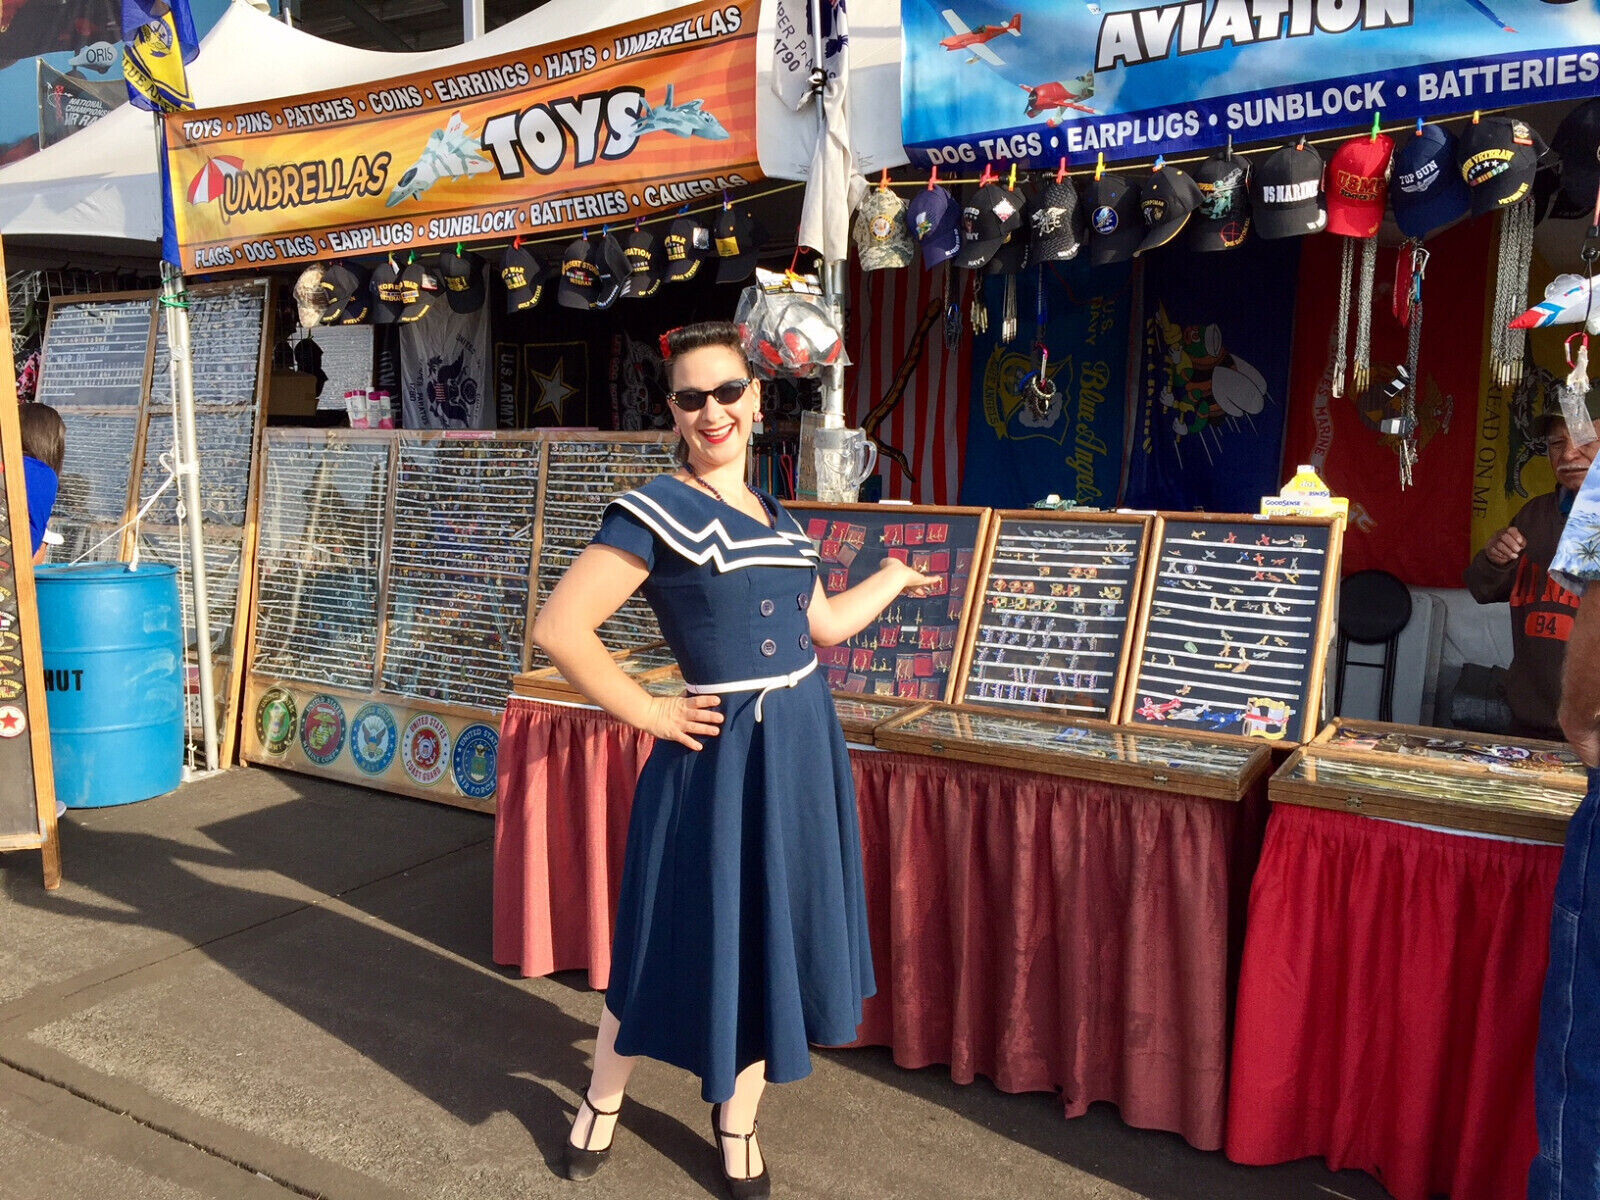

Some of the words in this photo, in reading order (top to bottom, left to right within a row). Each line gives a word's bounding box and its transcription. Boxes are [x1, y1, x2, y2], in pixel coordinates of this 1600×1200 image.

[1096, 0, 1413, 71] AVIATION
[86, 46, 114, 64] ORIS
[773, 38, 801, 72] 1790
[183, 120, 223, 140] TOYS
[236, 113, 272, 134] PINS
[287, 99, 356, 128] PATCHES
[369, 86, 423, 113] COINS
[434, 64, 529, 101] EARRINGS
[547, 48, 597, 79] HATS
[615, 6, 742, 60] UMBRELLAS
[65, 104, 111, 118] CHAMPIONS
[926, 145, 975, 165] DOG
[979, 132, 1042, 161] TAGS
[1067, 109, 1199, 153] EARPLUGS
[1227, 81, 1386, 131] SUNBLOCK
[1419, 53, 1599, 102] BATTERIES
[481, 86, 646, 180] TOYS
[223, 152, 392, 214] UMBRELLAS
[1399, 173, 1415, 185] TOP
[1416, 159, 1438, 180] GUN
[1263, 185, 1275, 203] US
[195, 248, 234, 269] FLAGS
[243, 241, 275, 261] DOG
[277, 236, 317, 258] TAGS
[327, 222, 414, 252] EARPLUGS
[428, 209, 518, 240] SUNBLOCK
[530, 190, 629, 226] BATTERIES
[644, 174, 749, 207] CAMERAS
[500, 382, 515, 428] ARMY
[1078, 360, 1110, 424] Blue
[1313, 406, 1333, 456] MARINE
[1064, 423, 1108, 505] Angels
[1476, 447, 1497, 479] ON
[1472, 485, 1491, 520] ME
[1536, 615, 1556, 635] 94
[409, 716, 429, 733] UNITED
[429, 717, 447, 740] STATES
[459, 728, 482, 747] UNITED
[458, 774, 470, 790] AIR
[470, 779, 496, 795] FORCE
